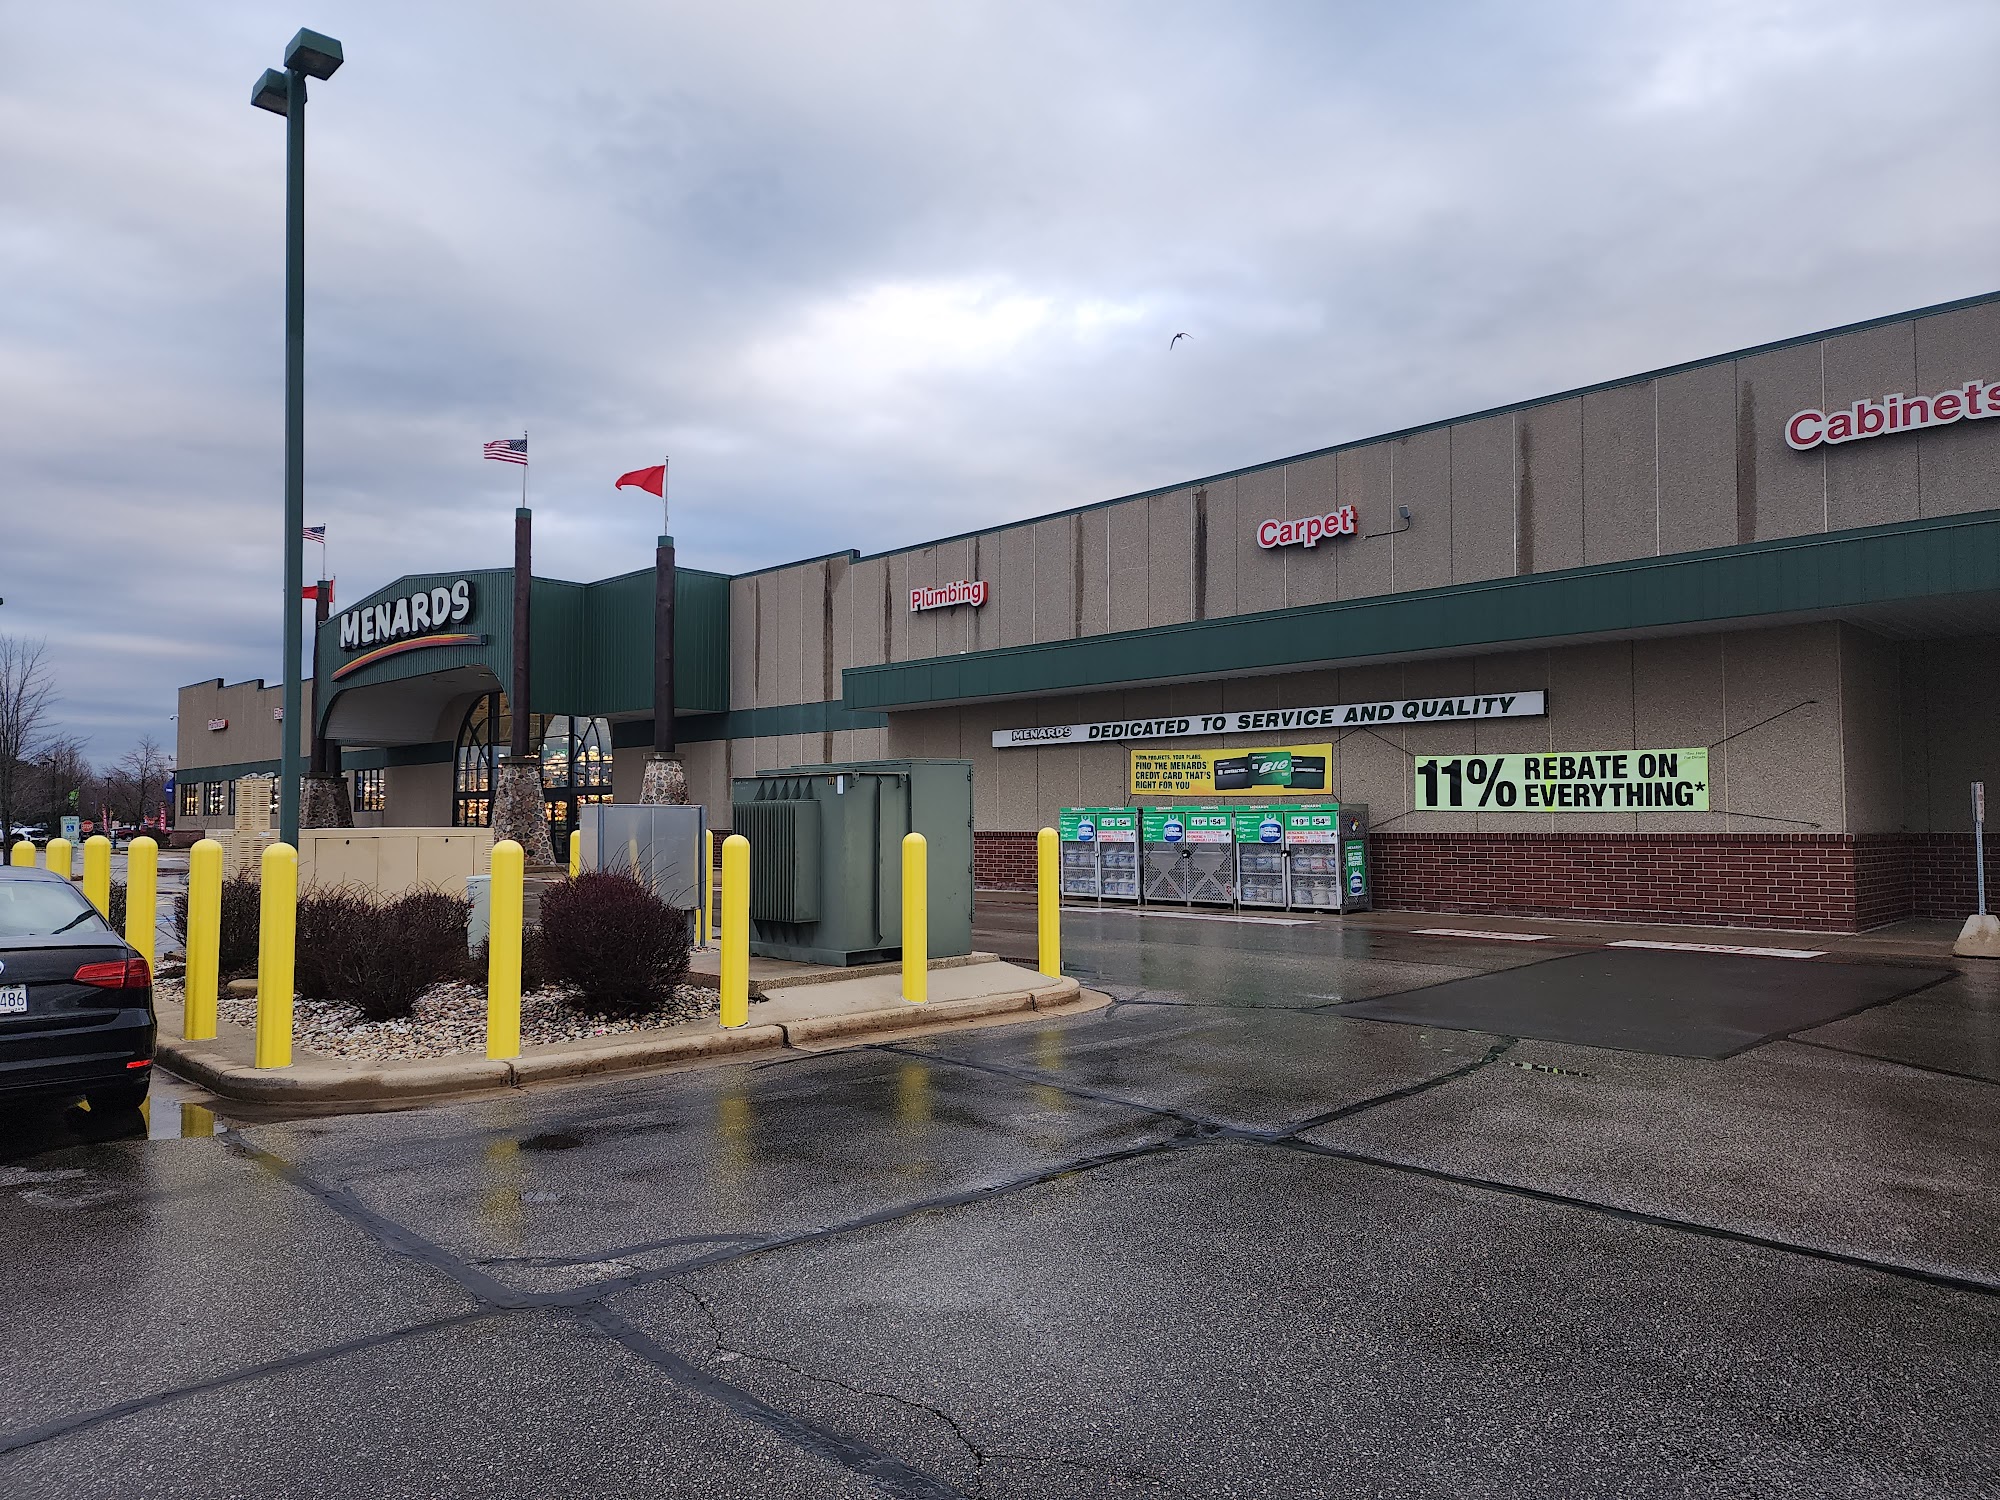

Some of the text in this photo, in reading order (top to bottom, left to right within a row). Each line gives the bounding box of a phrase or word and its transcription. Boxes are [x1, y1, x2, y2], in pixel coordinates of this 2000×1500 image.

[1789, 383, 2000, 445] Cabinets
[1259, 508, 1350, 546] Carpet
[911, 582, 981, 609] Plumbing
[339, 579, 470, 648] MENARDS
[1011, 696, 1516, 742] MENARDS DEDICATED TO SERVICE AND QUALITY
[1135, 762, 1152, 770] FIND
[1135, 771, 1211, 780] CREDIT CARD THAT'S
[1258, 759, 1289, 774] BIG
[1524, 753, 1678, 780] REBATE ON
[1135, 781, 1190, 789] RIGHT FOR YOU
[1417, 758, 1518, 807] 11%
[0, 991, 25, 1008] 486
